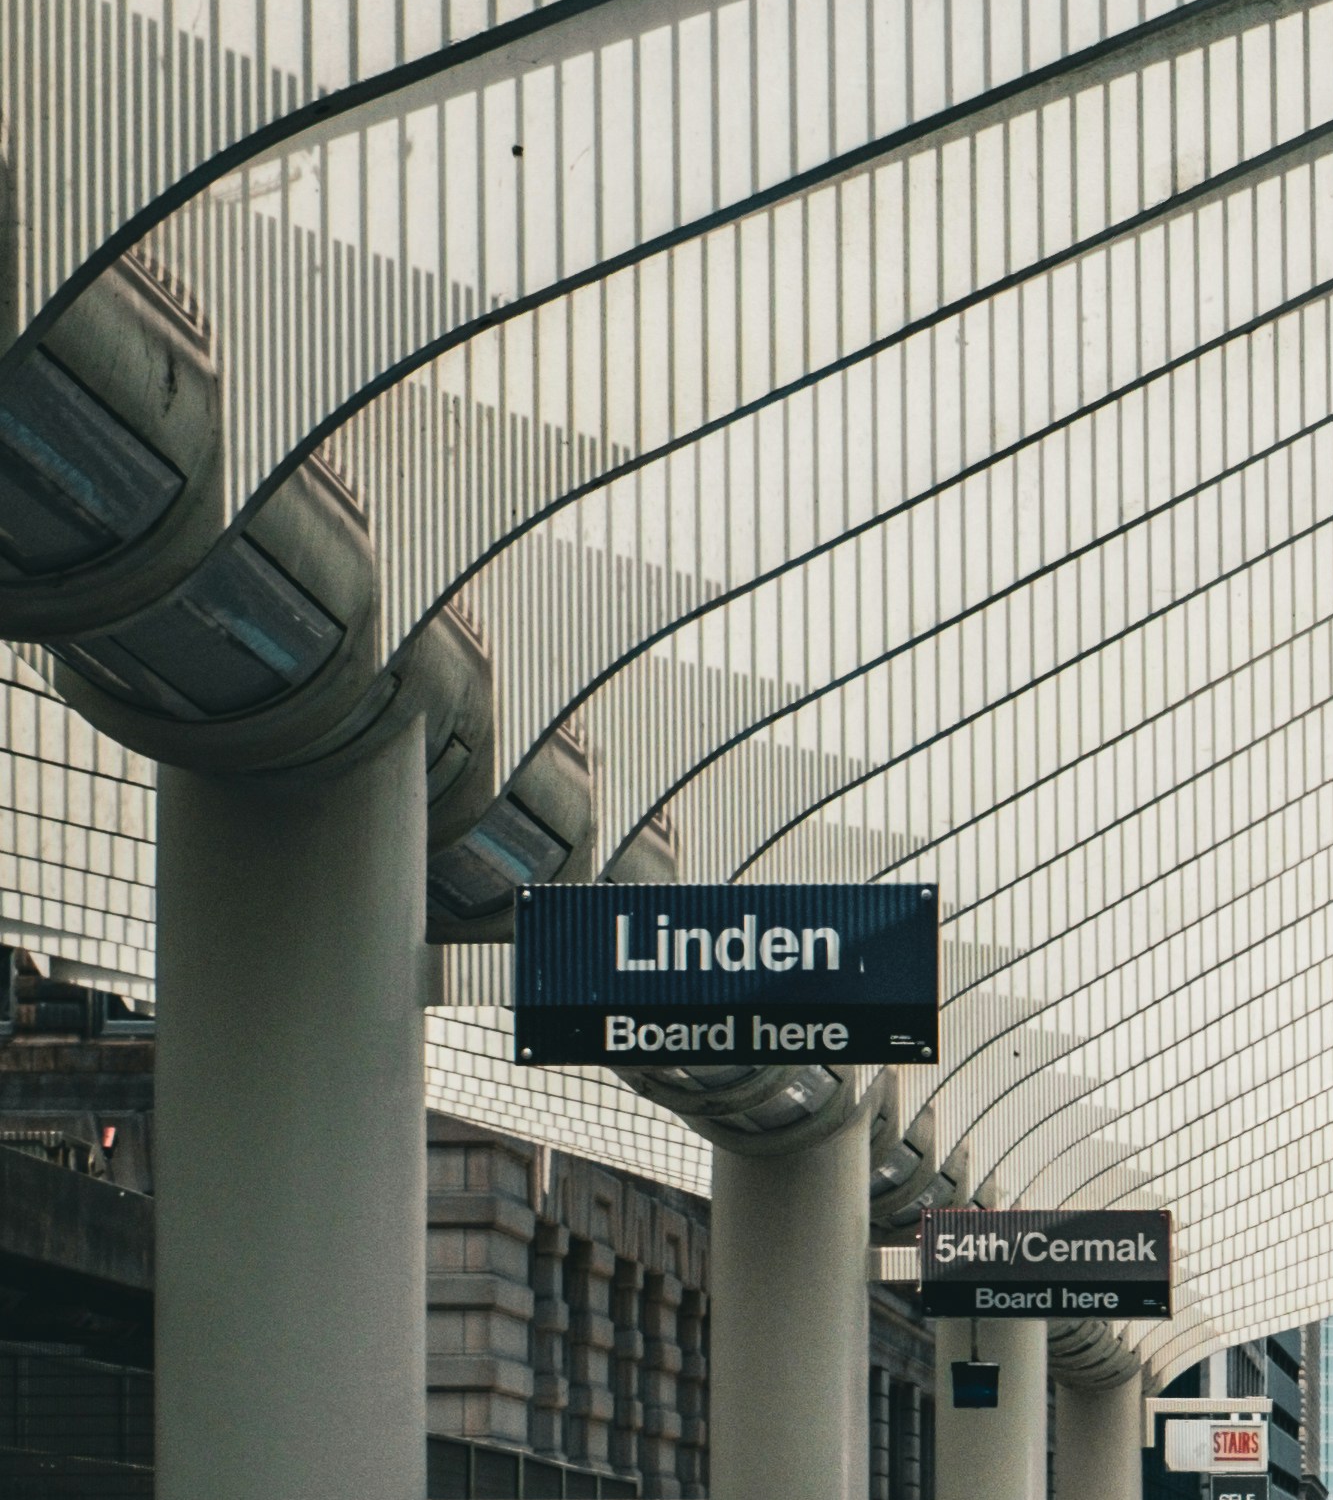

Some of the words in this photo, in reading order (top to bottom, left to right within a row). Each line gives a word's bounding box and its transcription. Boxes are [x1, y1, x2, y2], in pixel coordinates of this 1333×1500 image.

[616, 913, 840, 972] Linden
[605, 1015, 734, 1052] Board
[752, 1015, 849, 1052] here
[935, 1231, 1158, 1266] 54th/Cermak
[975, 1287, 1052, 1309] Board
[1062, 1287, 1119, 1309] here
[1213, 1431, 1260, 1454] STAIRS
